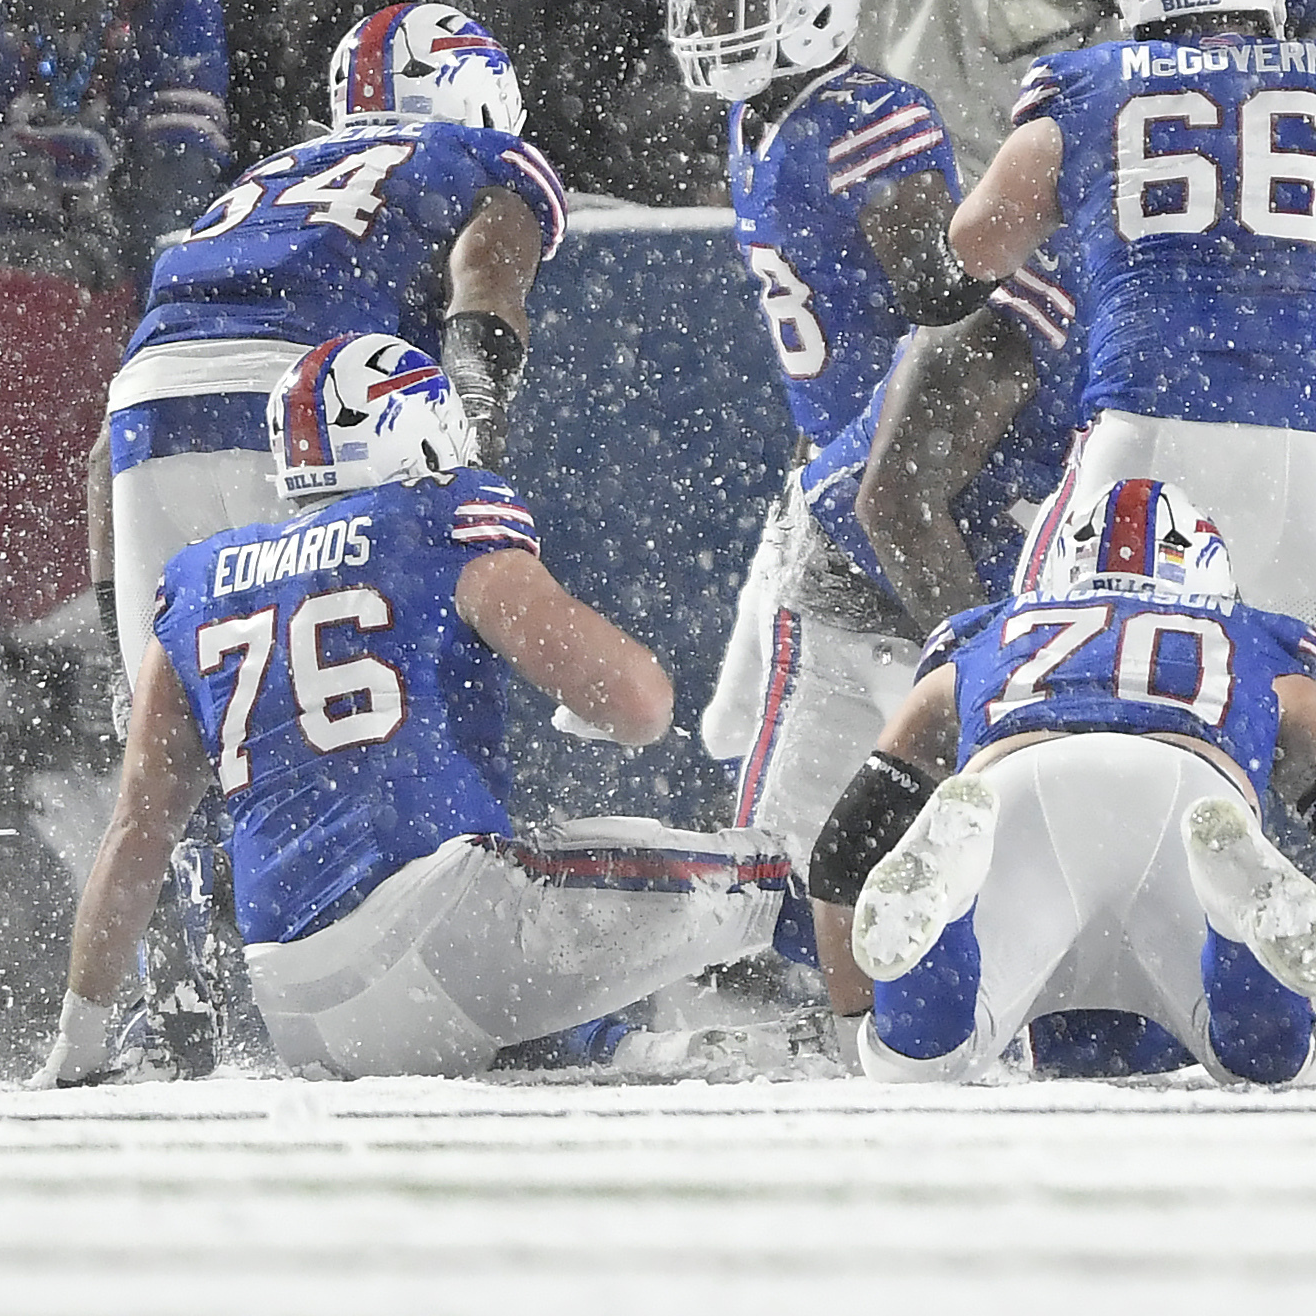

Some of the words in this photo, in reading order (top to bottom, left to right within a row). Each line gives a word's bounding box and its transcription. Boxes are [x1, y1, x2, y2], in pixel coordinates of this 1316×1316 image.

[213, 515, 373, 598] EDWARDS
[195, 585, 410, 799] 76
[984, 602, 1236, 730] 70
